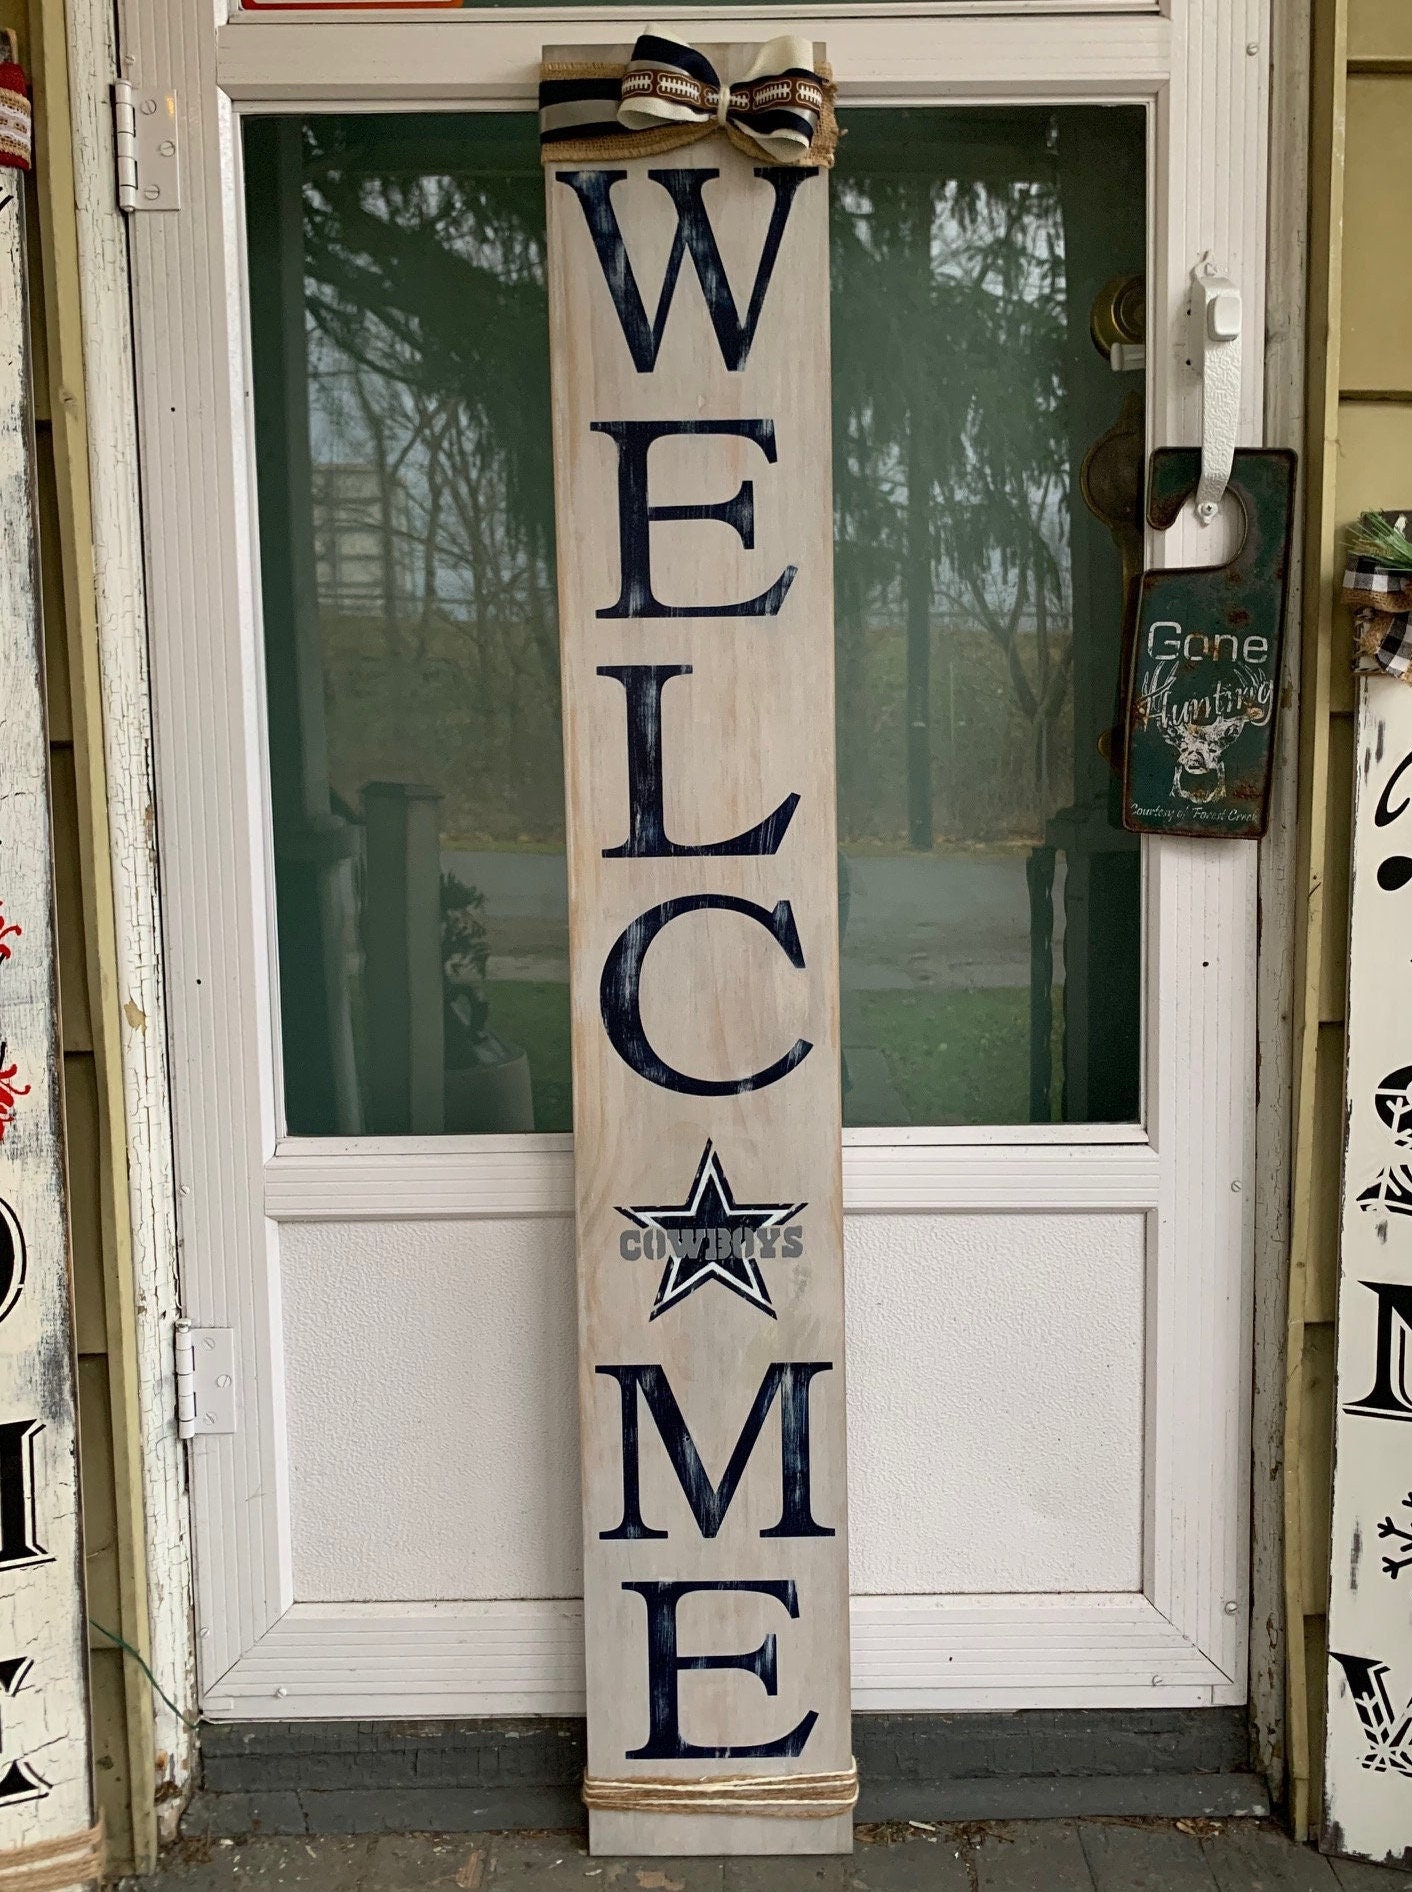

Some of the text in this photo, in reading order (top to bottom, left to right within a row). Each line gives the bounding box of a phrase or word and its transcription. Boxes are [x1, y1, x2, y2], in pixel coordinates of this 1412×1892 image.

[1147, 621, 1269, 664] Gone
[1142, 677, 1274, 733] Hunting
[619, 1225, 804, 1262] COWBOYS
